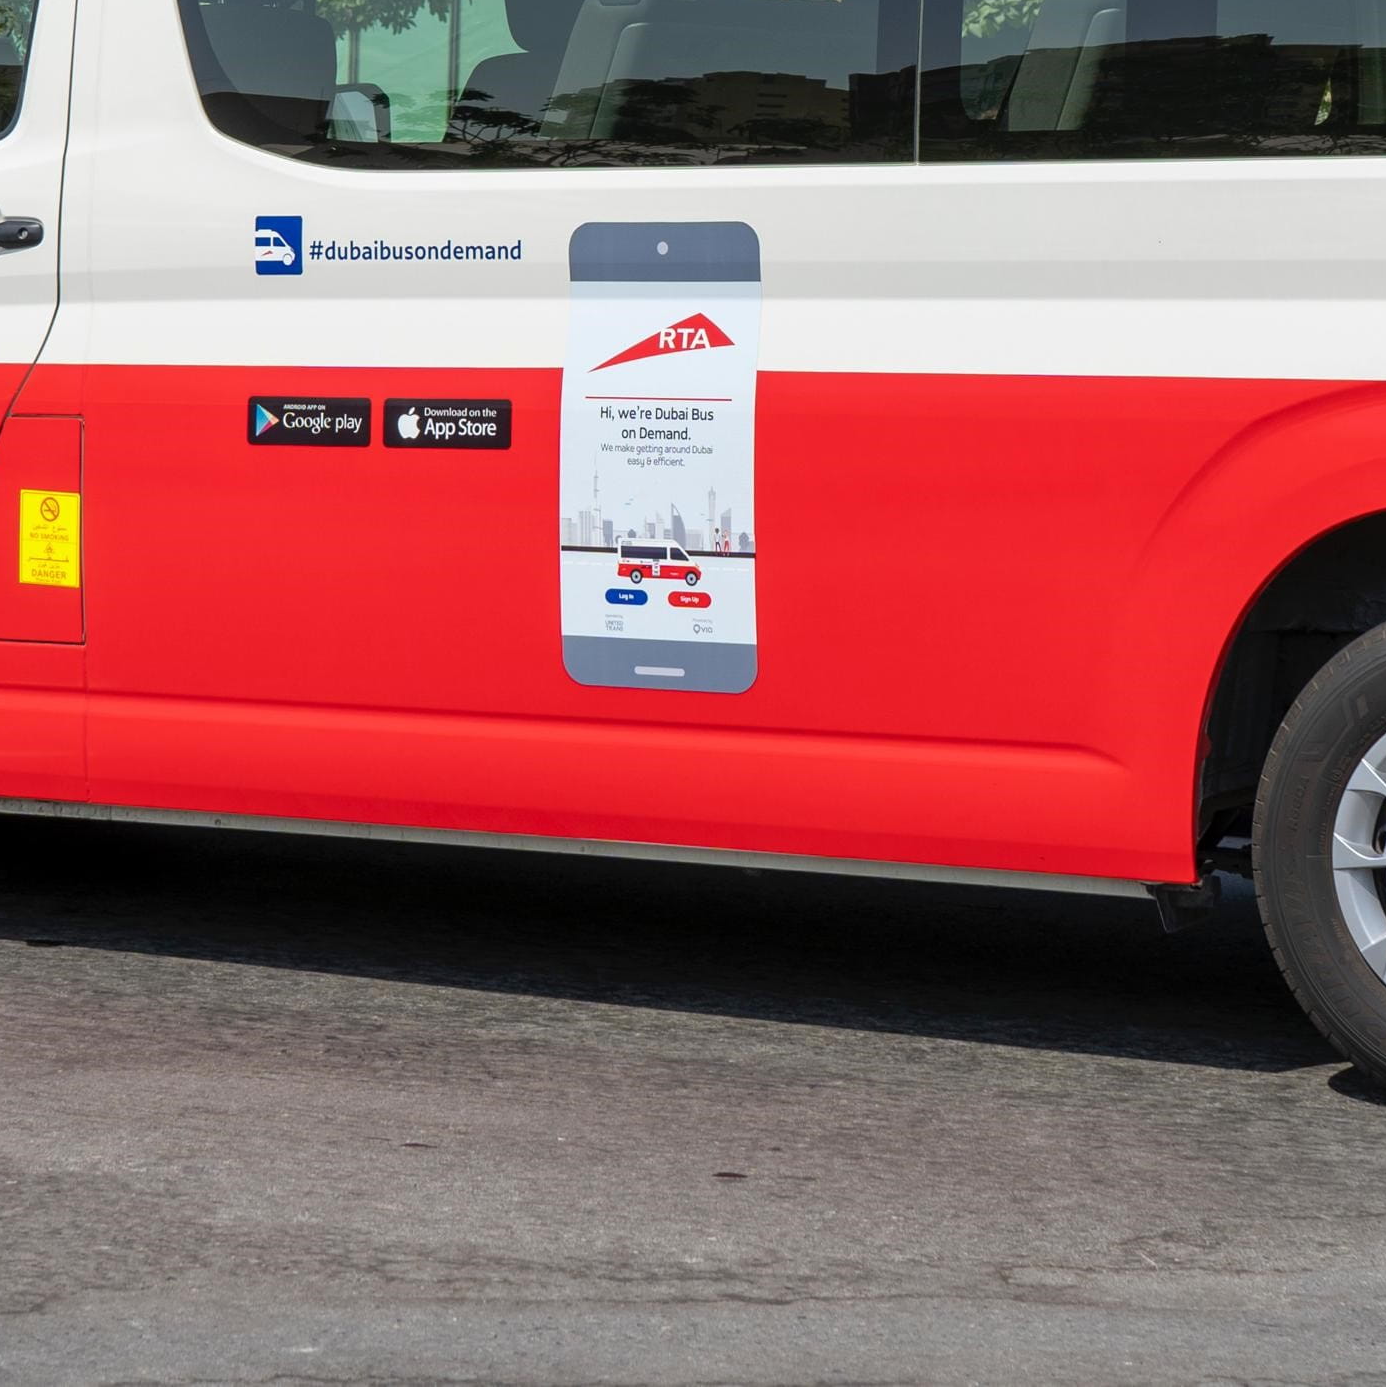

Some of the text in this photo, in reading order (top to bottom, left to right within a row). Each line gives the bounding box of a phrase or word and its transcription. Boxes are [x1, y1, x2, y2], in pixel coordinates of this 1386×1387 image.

[309, 240, 521, 261] #dubaibusondemand
[658, 328, 711, 350] RTA
[424, 407, 497, 418] Download on the
[600, 406, 614, 421] Hi,
[655, 407, 689, 421] Dubai
[691, 408, 714, 421] Bus
[283, 411, 363, 434] Google play
[424, 419, 497, 439] App Store
[621, 427, 691, 441] on Demand.
[601, 443, 713, 455] We make getting around Dubai
[627, 458, 645, 468] easy
[653, 457, 685, 467] efficient.
[30, 531, 69, 542] NO SMOKING
[31, 568, 67, 580] DANGER
